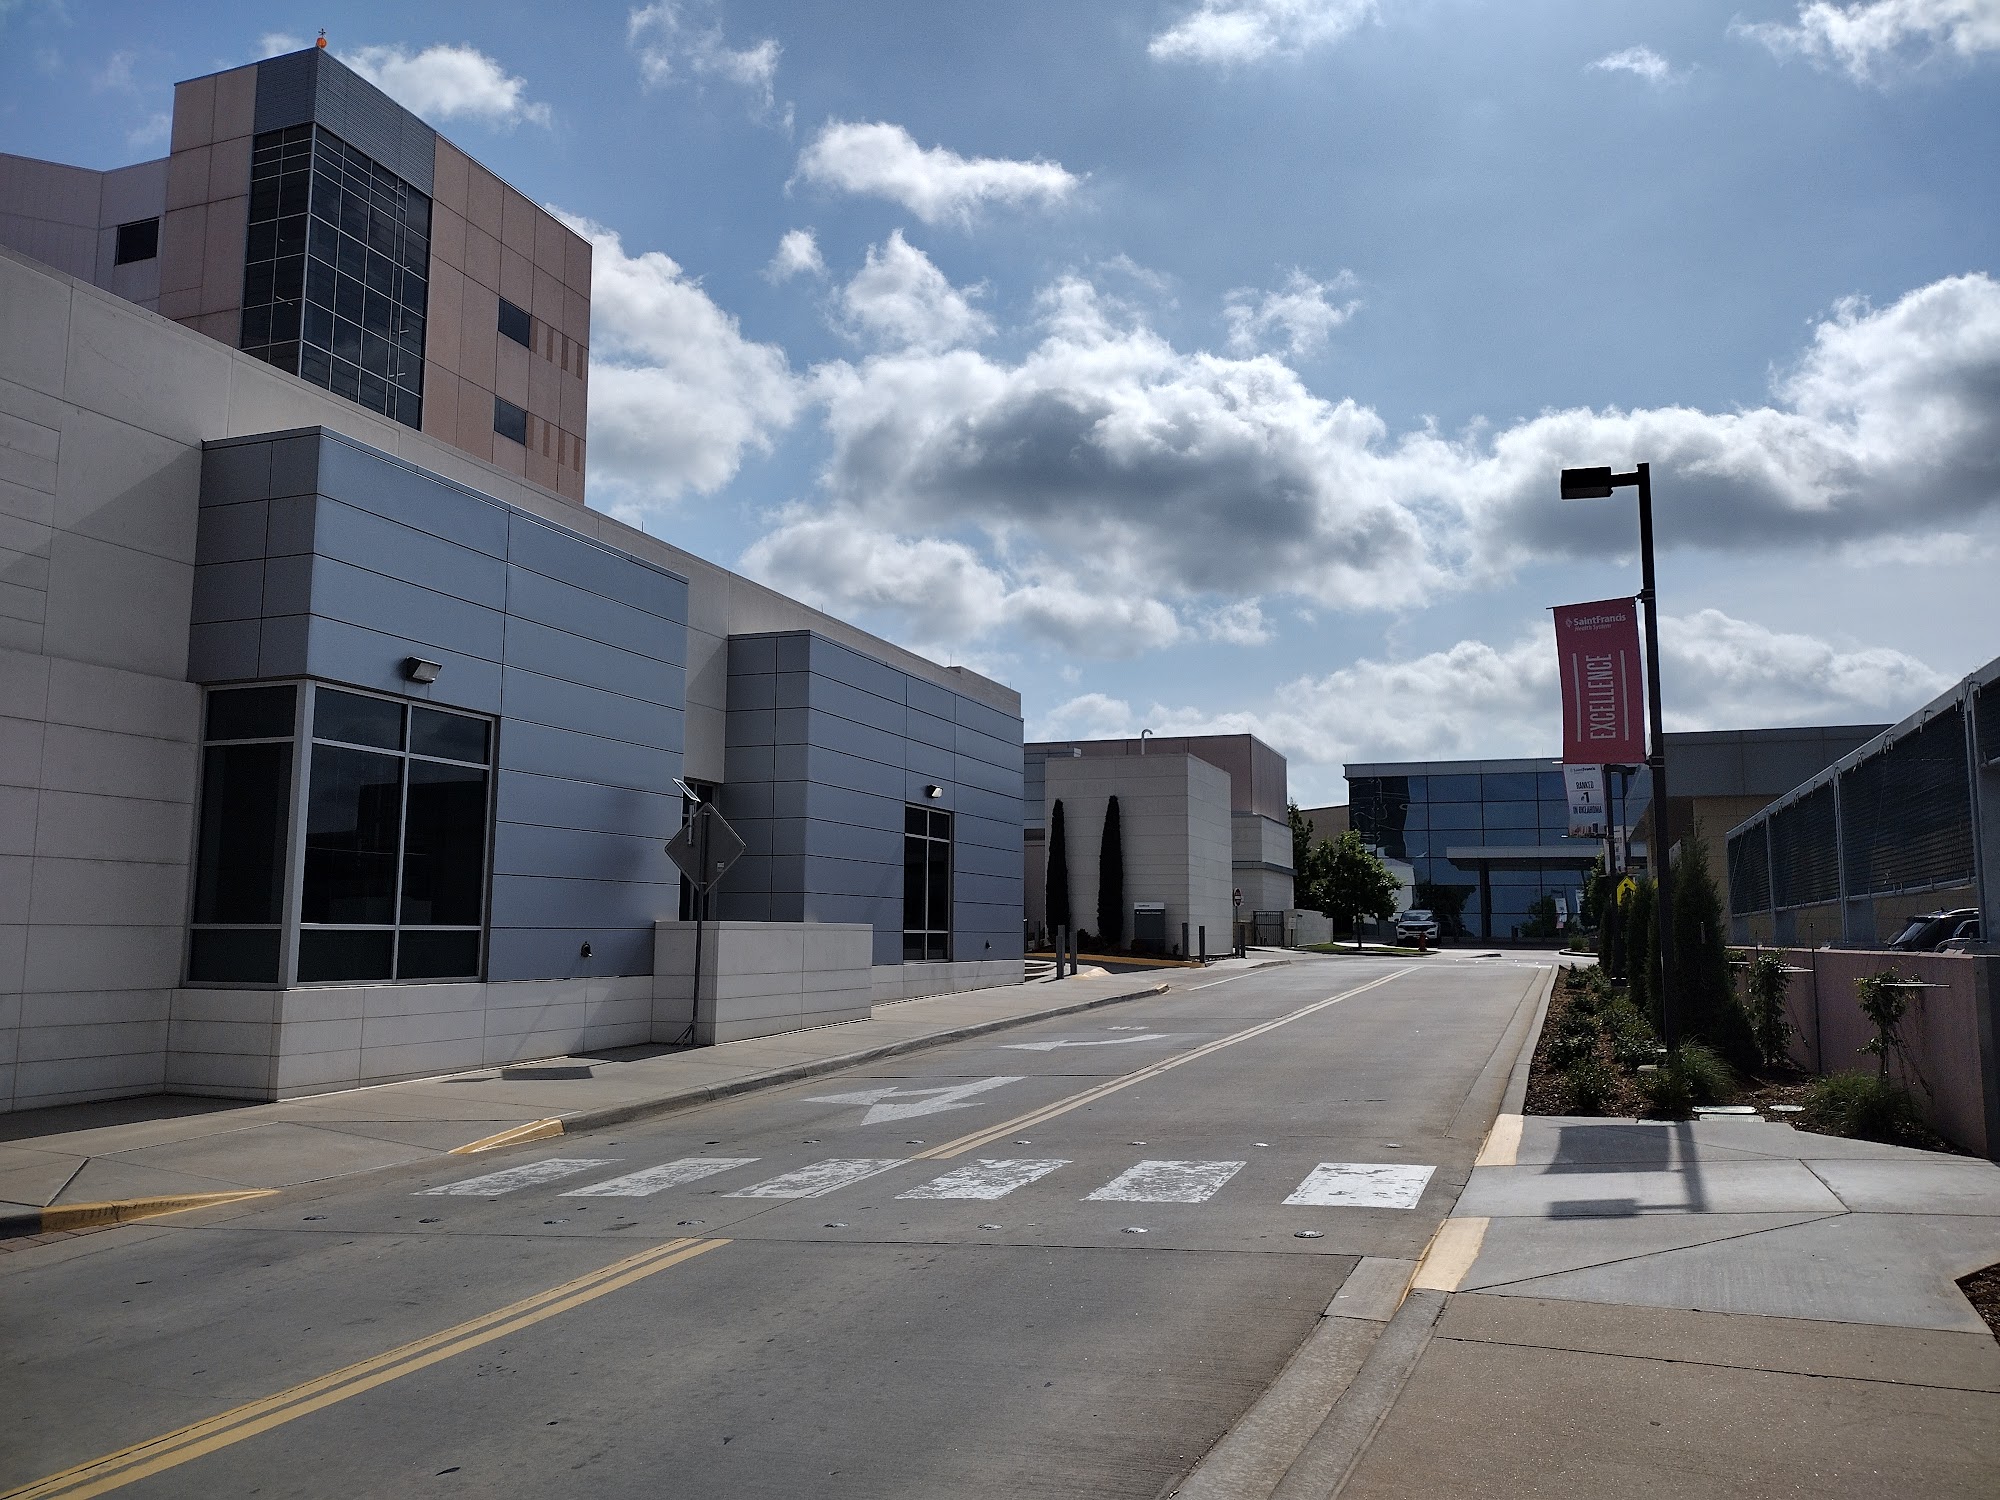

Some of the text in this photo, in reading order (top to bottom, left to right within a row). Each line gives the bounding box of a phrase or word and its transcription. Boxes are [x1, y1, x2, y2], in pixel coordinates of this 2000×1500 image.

[1574, 623, 1612, 632] Health System
[1586, 653, 1616, 739] EXCELLENCE
[1576, 781, 1594, 789] RANKED
